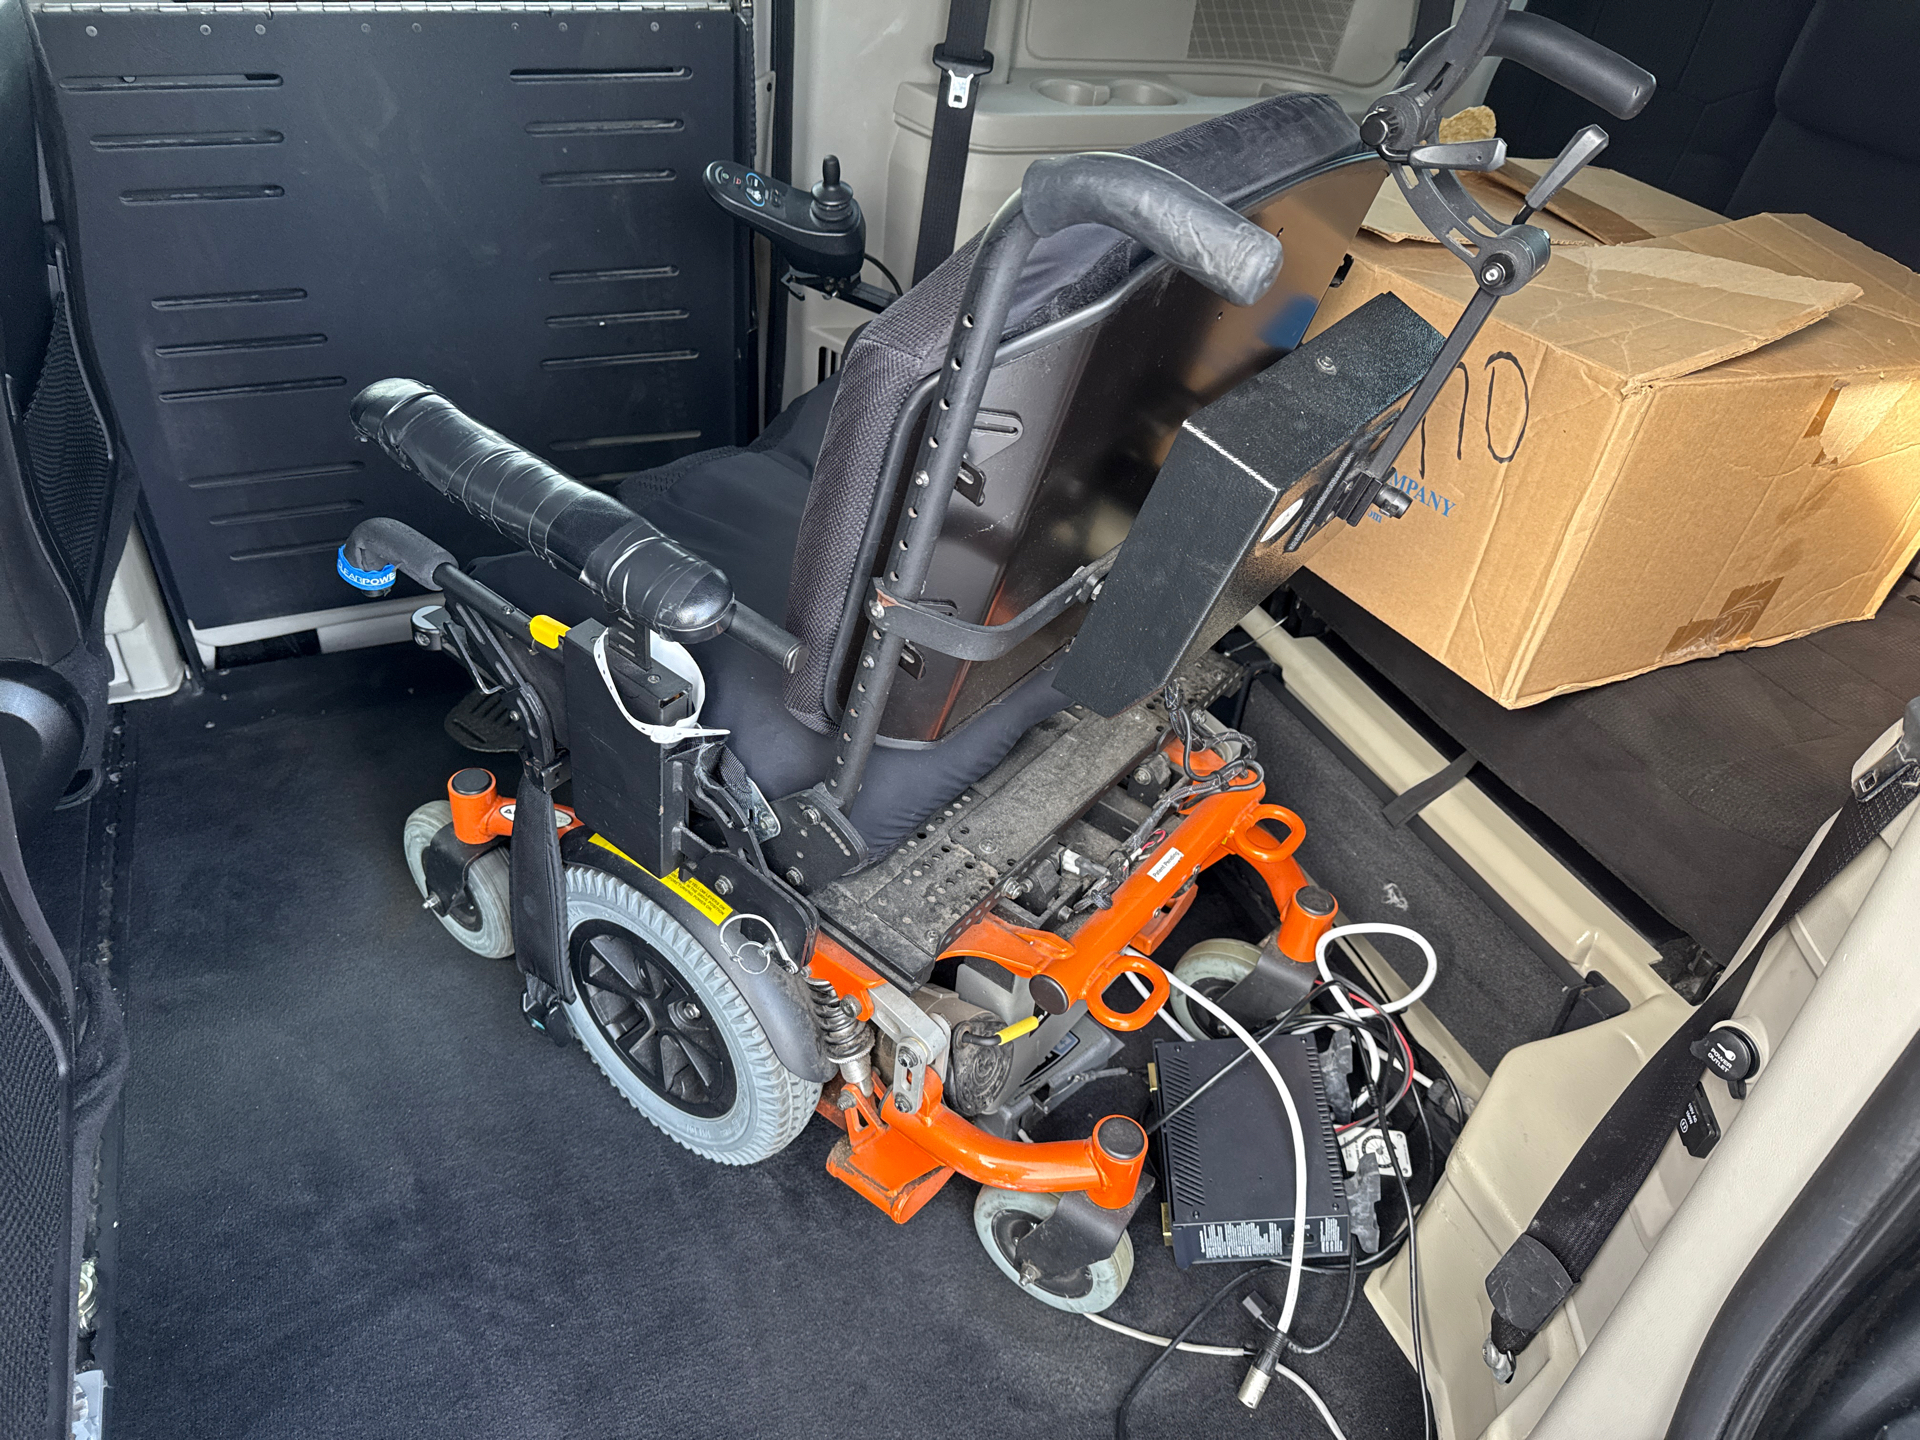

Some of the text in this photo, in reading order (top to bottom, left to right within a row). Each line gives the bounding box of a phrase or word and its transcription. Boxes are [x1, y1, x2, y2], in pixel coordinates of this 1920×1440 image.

[1389, 471, 1456, 518] MPANY
[1152, 851, 1180, 878] Patent Pending
[678, 881, 694, 896] TURNING
[693, 894, 707, 906] POWER
[692, 881, 707, 894] YELLOW
[708, 900, 725, 916] POSITION
[1707, 1052, 1730, 1073] OUTLET
[1710, 1047, 1733, 1069] POWER
